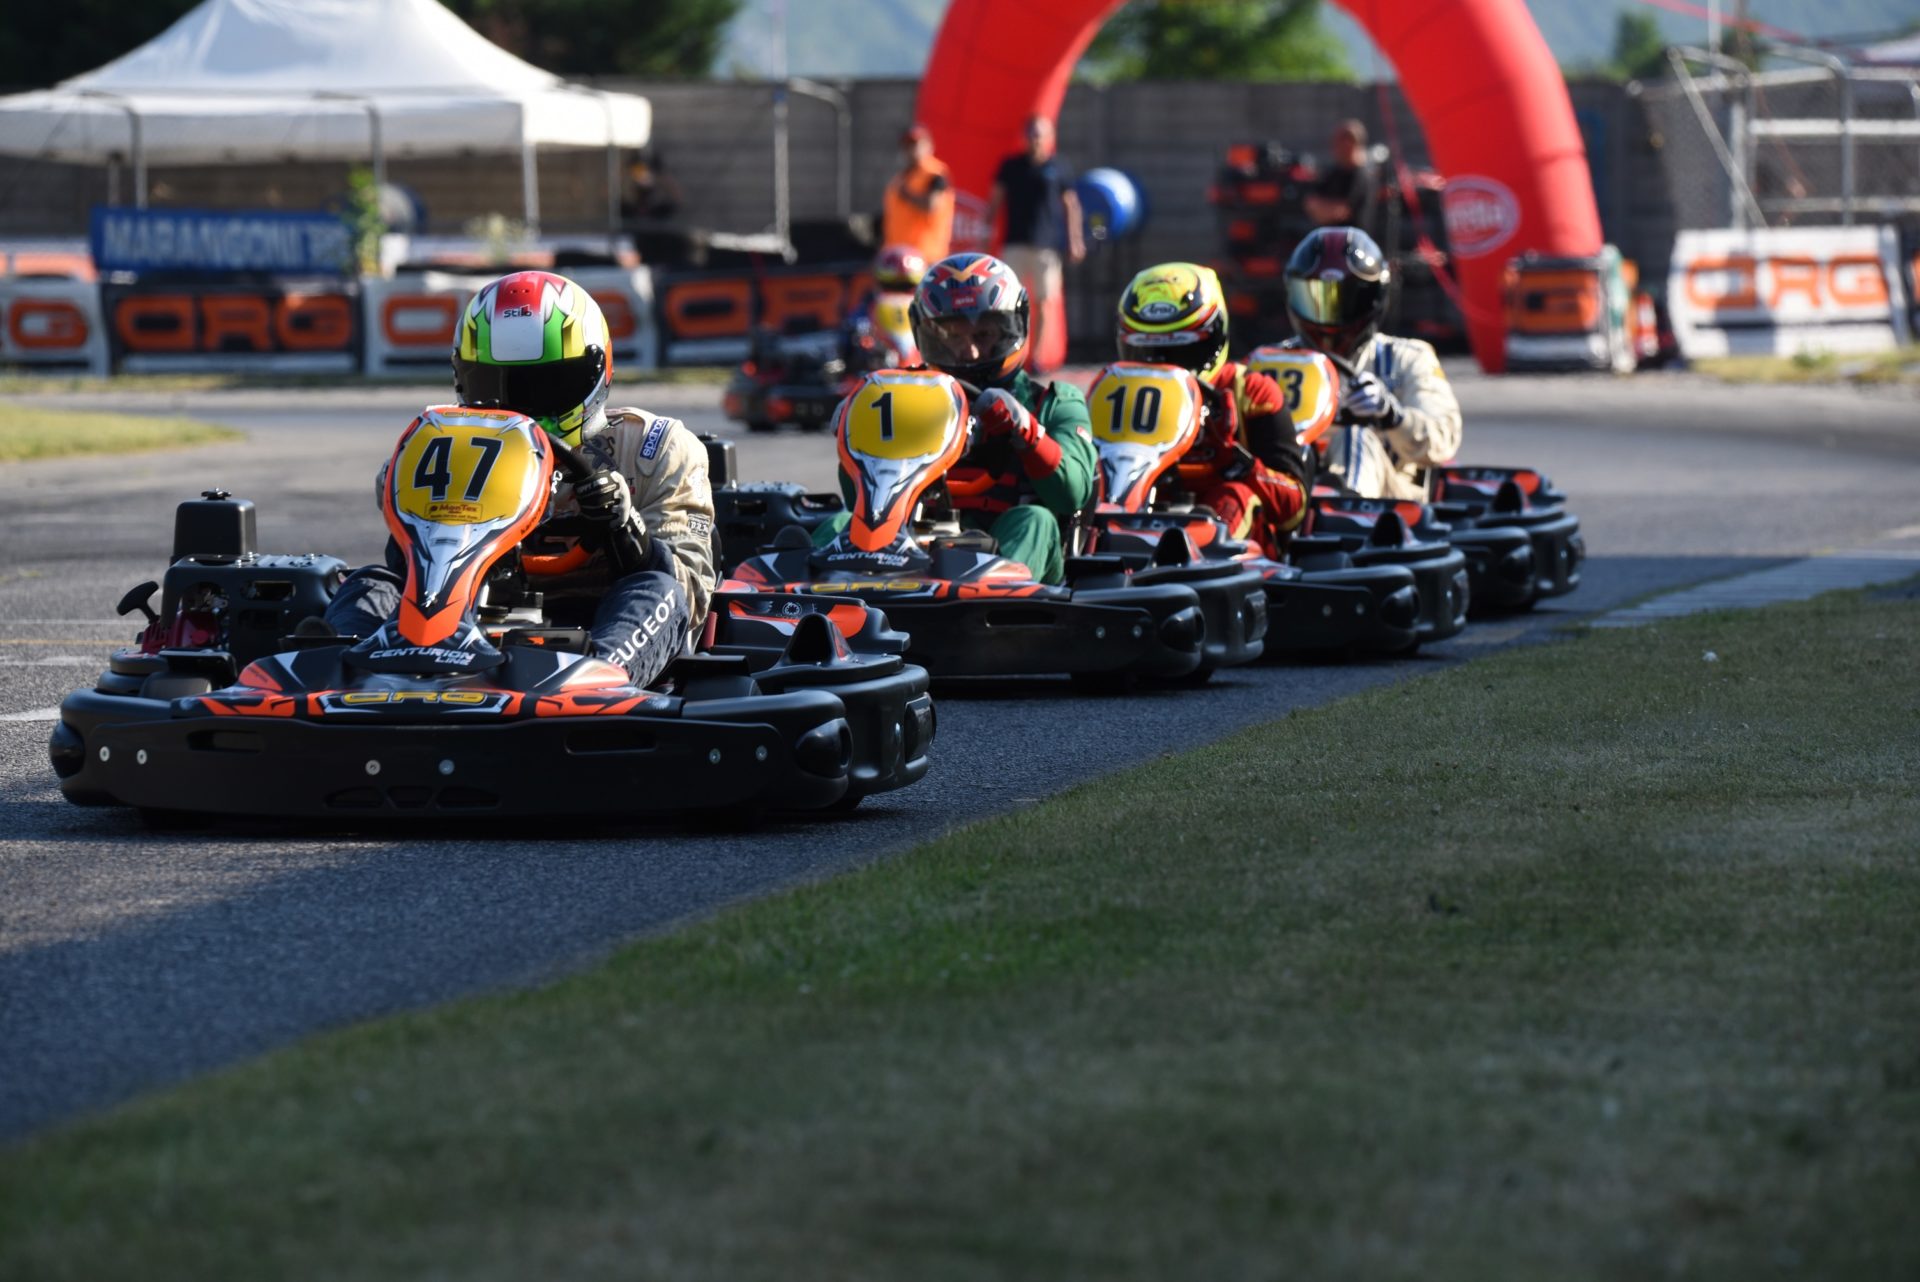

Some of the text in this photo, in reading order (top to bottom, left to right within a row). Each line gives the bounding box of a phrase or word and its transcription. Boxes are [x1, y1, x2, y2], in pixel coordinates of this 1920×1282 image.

[379, 293, 637, 349] CG
[870, 391, 895, 441] 1
[1104, 385, 1162, 435] 10
[412, 435, 504, 502] 47
[827, 551, 910, 562] CENTURION
[607, 588, 677, 668] EUGEOT
[369, 646, 477, 661] CENTURION
[434, 656, 473, 667] LINE
